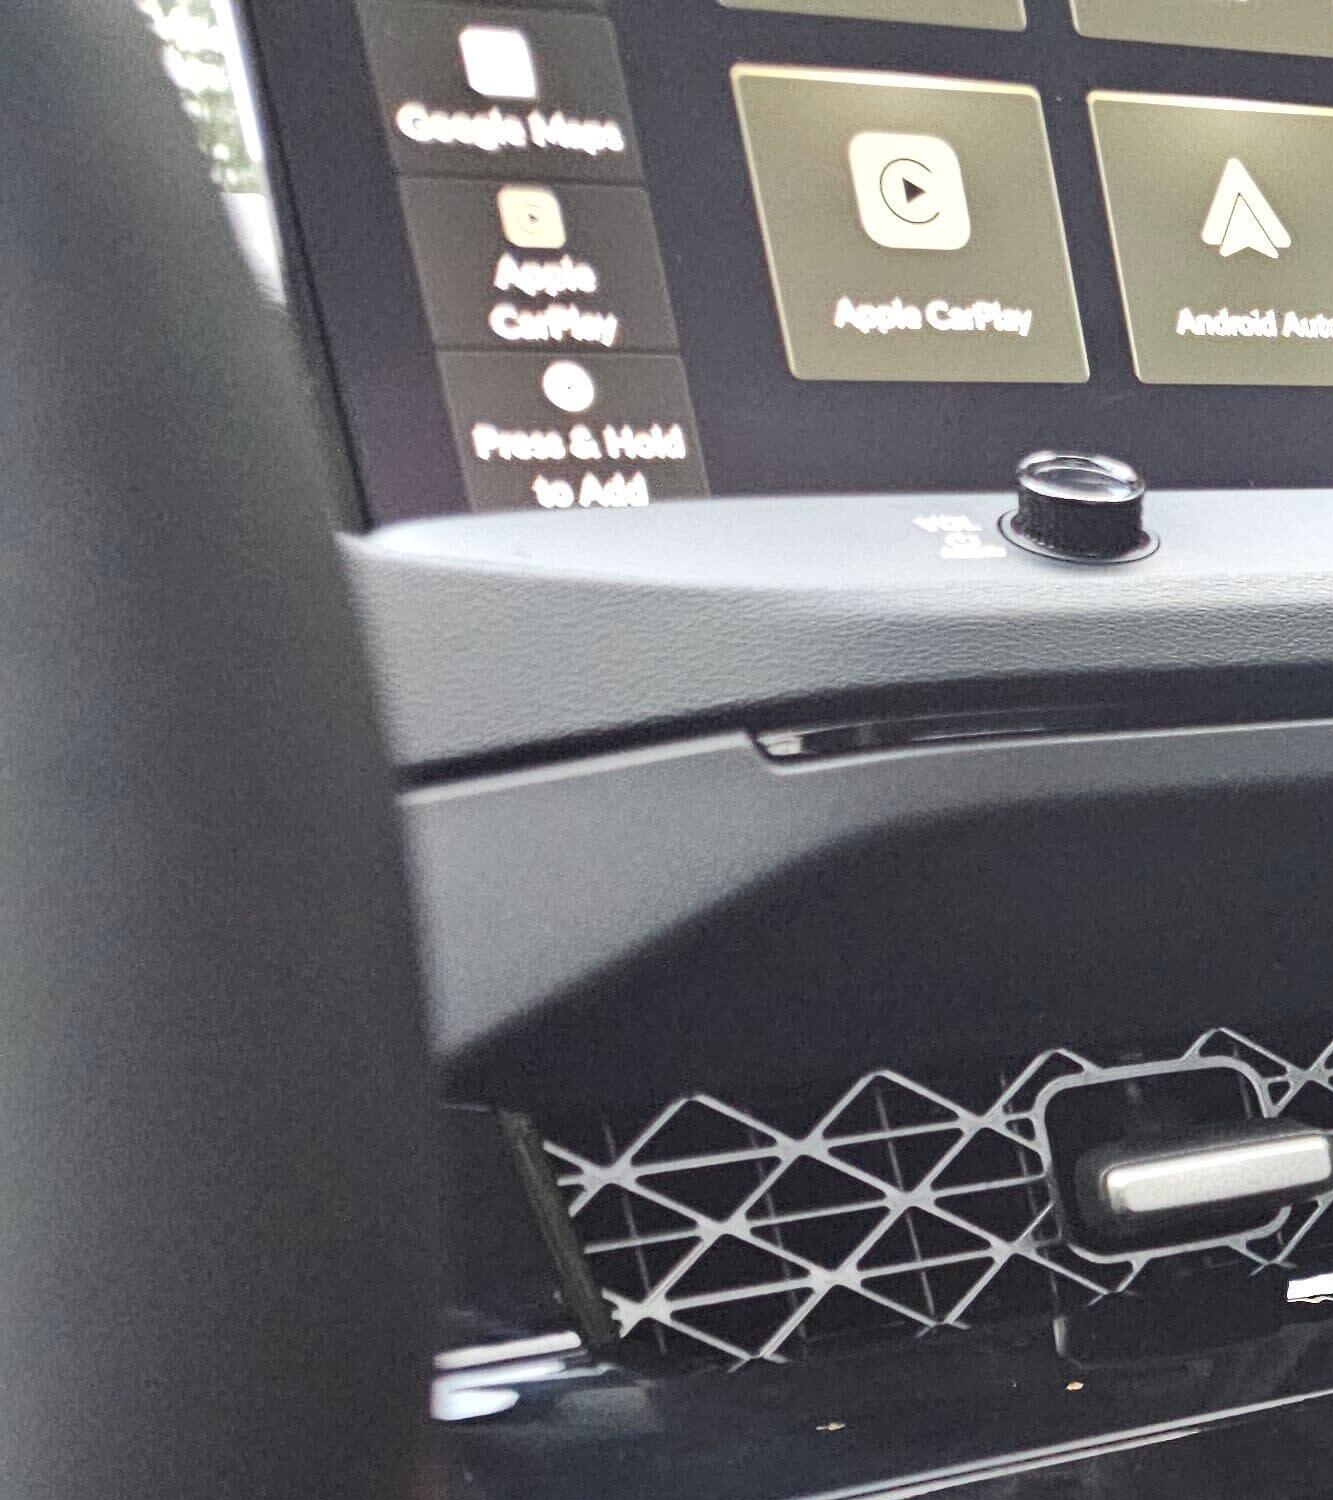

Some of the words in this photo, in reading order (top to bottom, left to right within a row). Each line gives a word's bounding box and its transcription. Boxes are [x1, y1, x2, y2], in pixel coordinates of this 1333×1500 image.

[396, 102, 526, 151] Google
[528, 109, 625, 156] Maps
[494, 253, 598, 297] Apple
[488, 302, 619, 347] CarPlay
[834, 295, 923, 334] Apple
[925, 299, 1033, 337] CarPlay
[1176, 307, 1278, 338] Android
[471, 422, 566, 461] Press
[568, 423, 602, 460] &
[602, 423, 687, 460] Hold
[531, 474, 575, 509] to
[578, 471, 650, 508] Add
